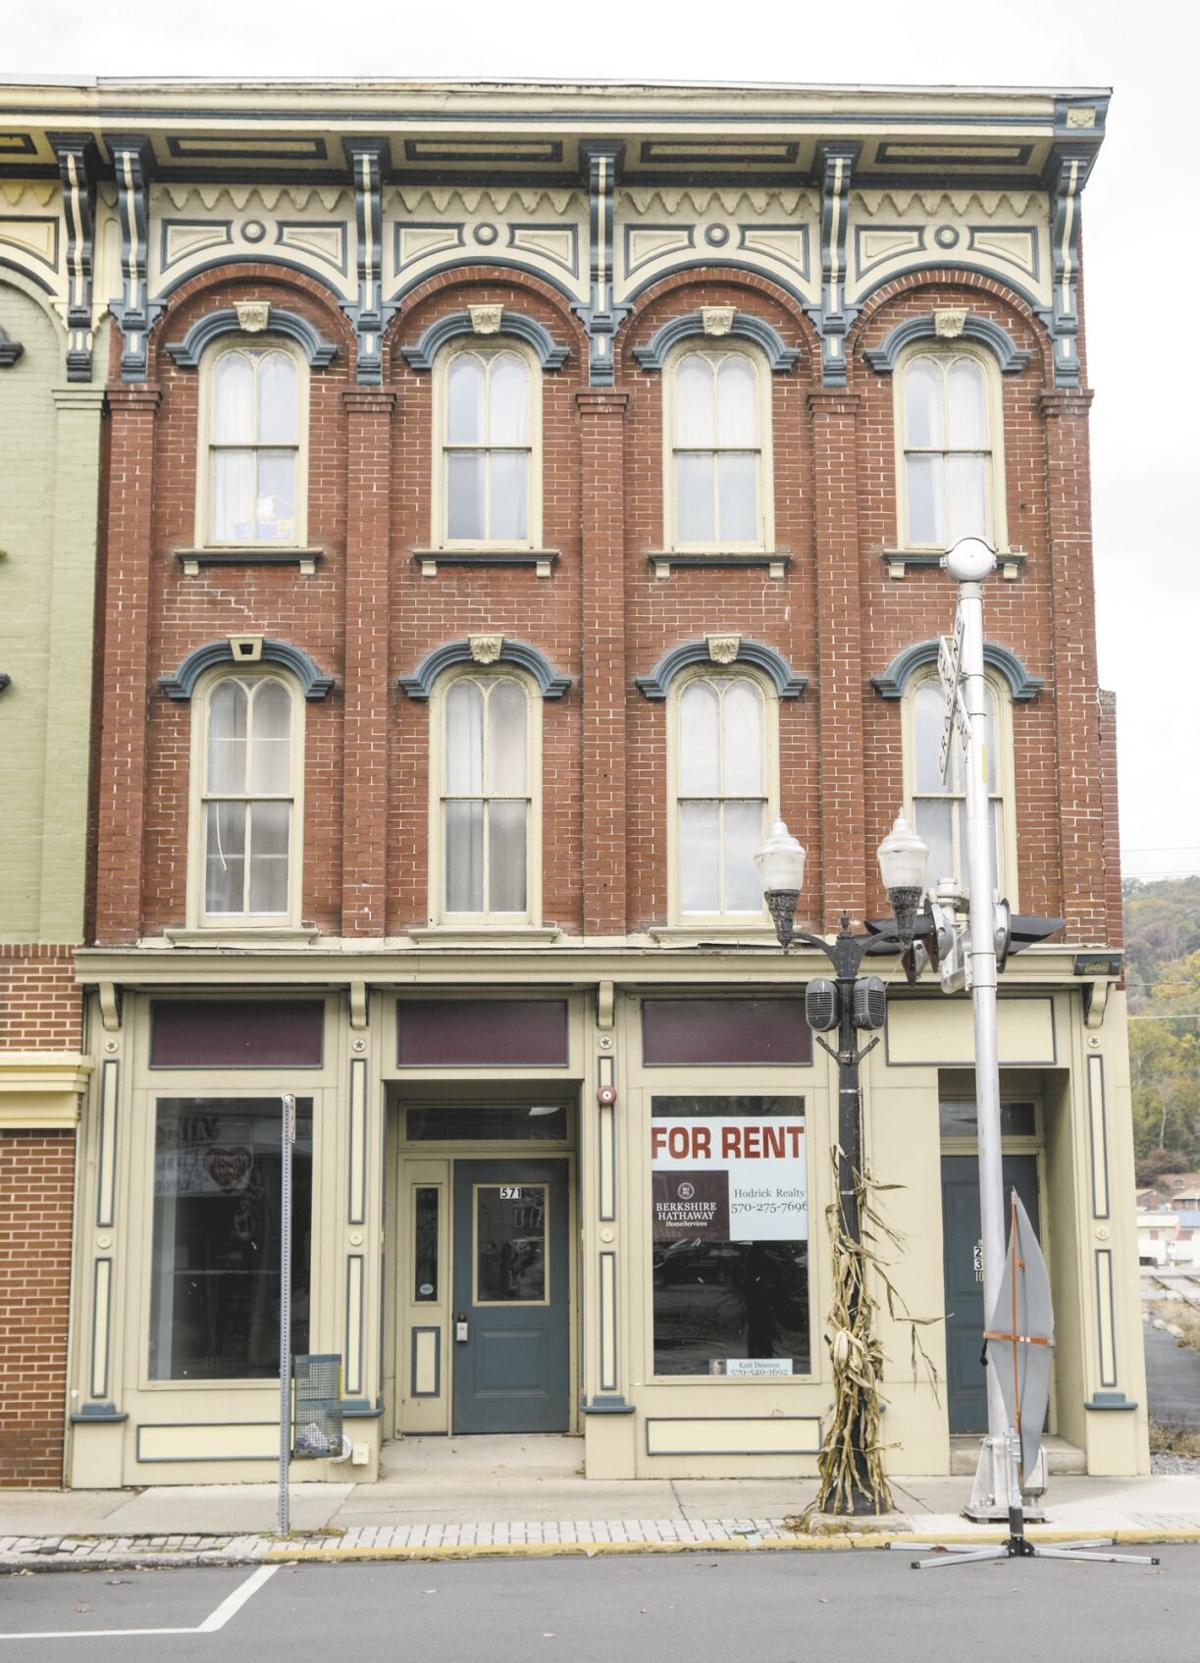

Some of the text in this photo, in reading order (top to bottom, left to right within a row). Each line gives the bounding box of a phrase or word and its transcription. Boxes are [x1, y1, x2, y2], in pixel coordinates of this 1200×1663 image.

[651, 1126, 804, 1159] FOR RENT
[501, 1187, 520, 1198] 571
[734, 1188, 805, 1200] Hodrick Realty
[656, 1202, 717, 1211] BERKSHIRE
[658, 1211, 715, 1220] HATHAWAY
[975, 1247, 982, 1258] 2
[975, 1259, 983, 1270] 3
